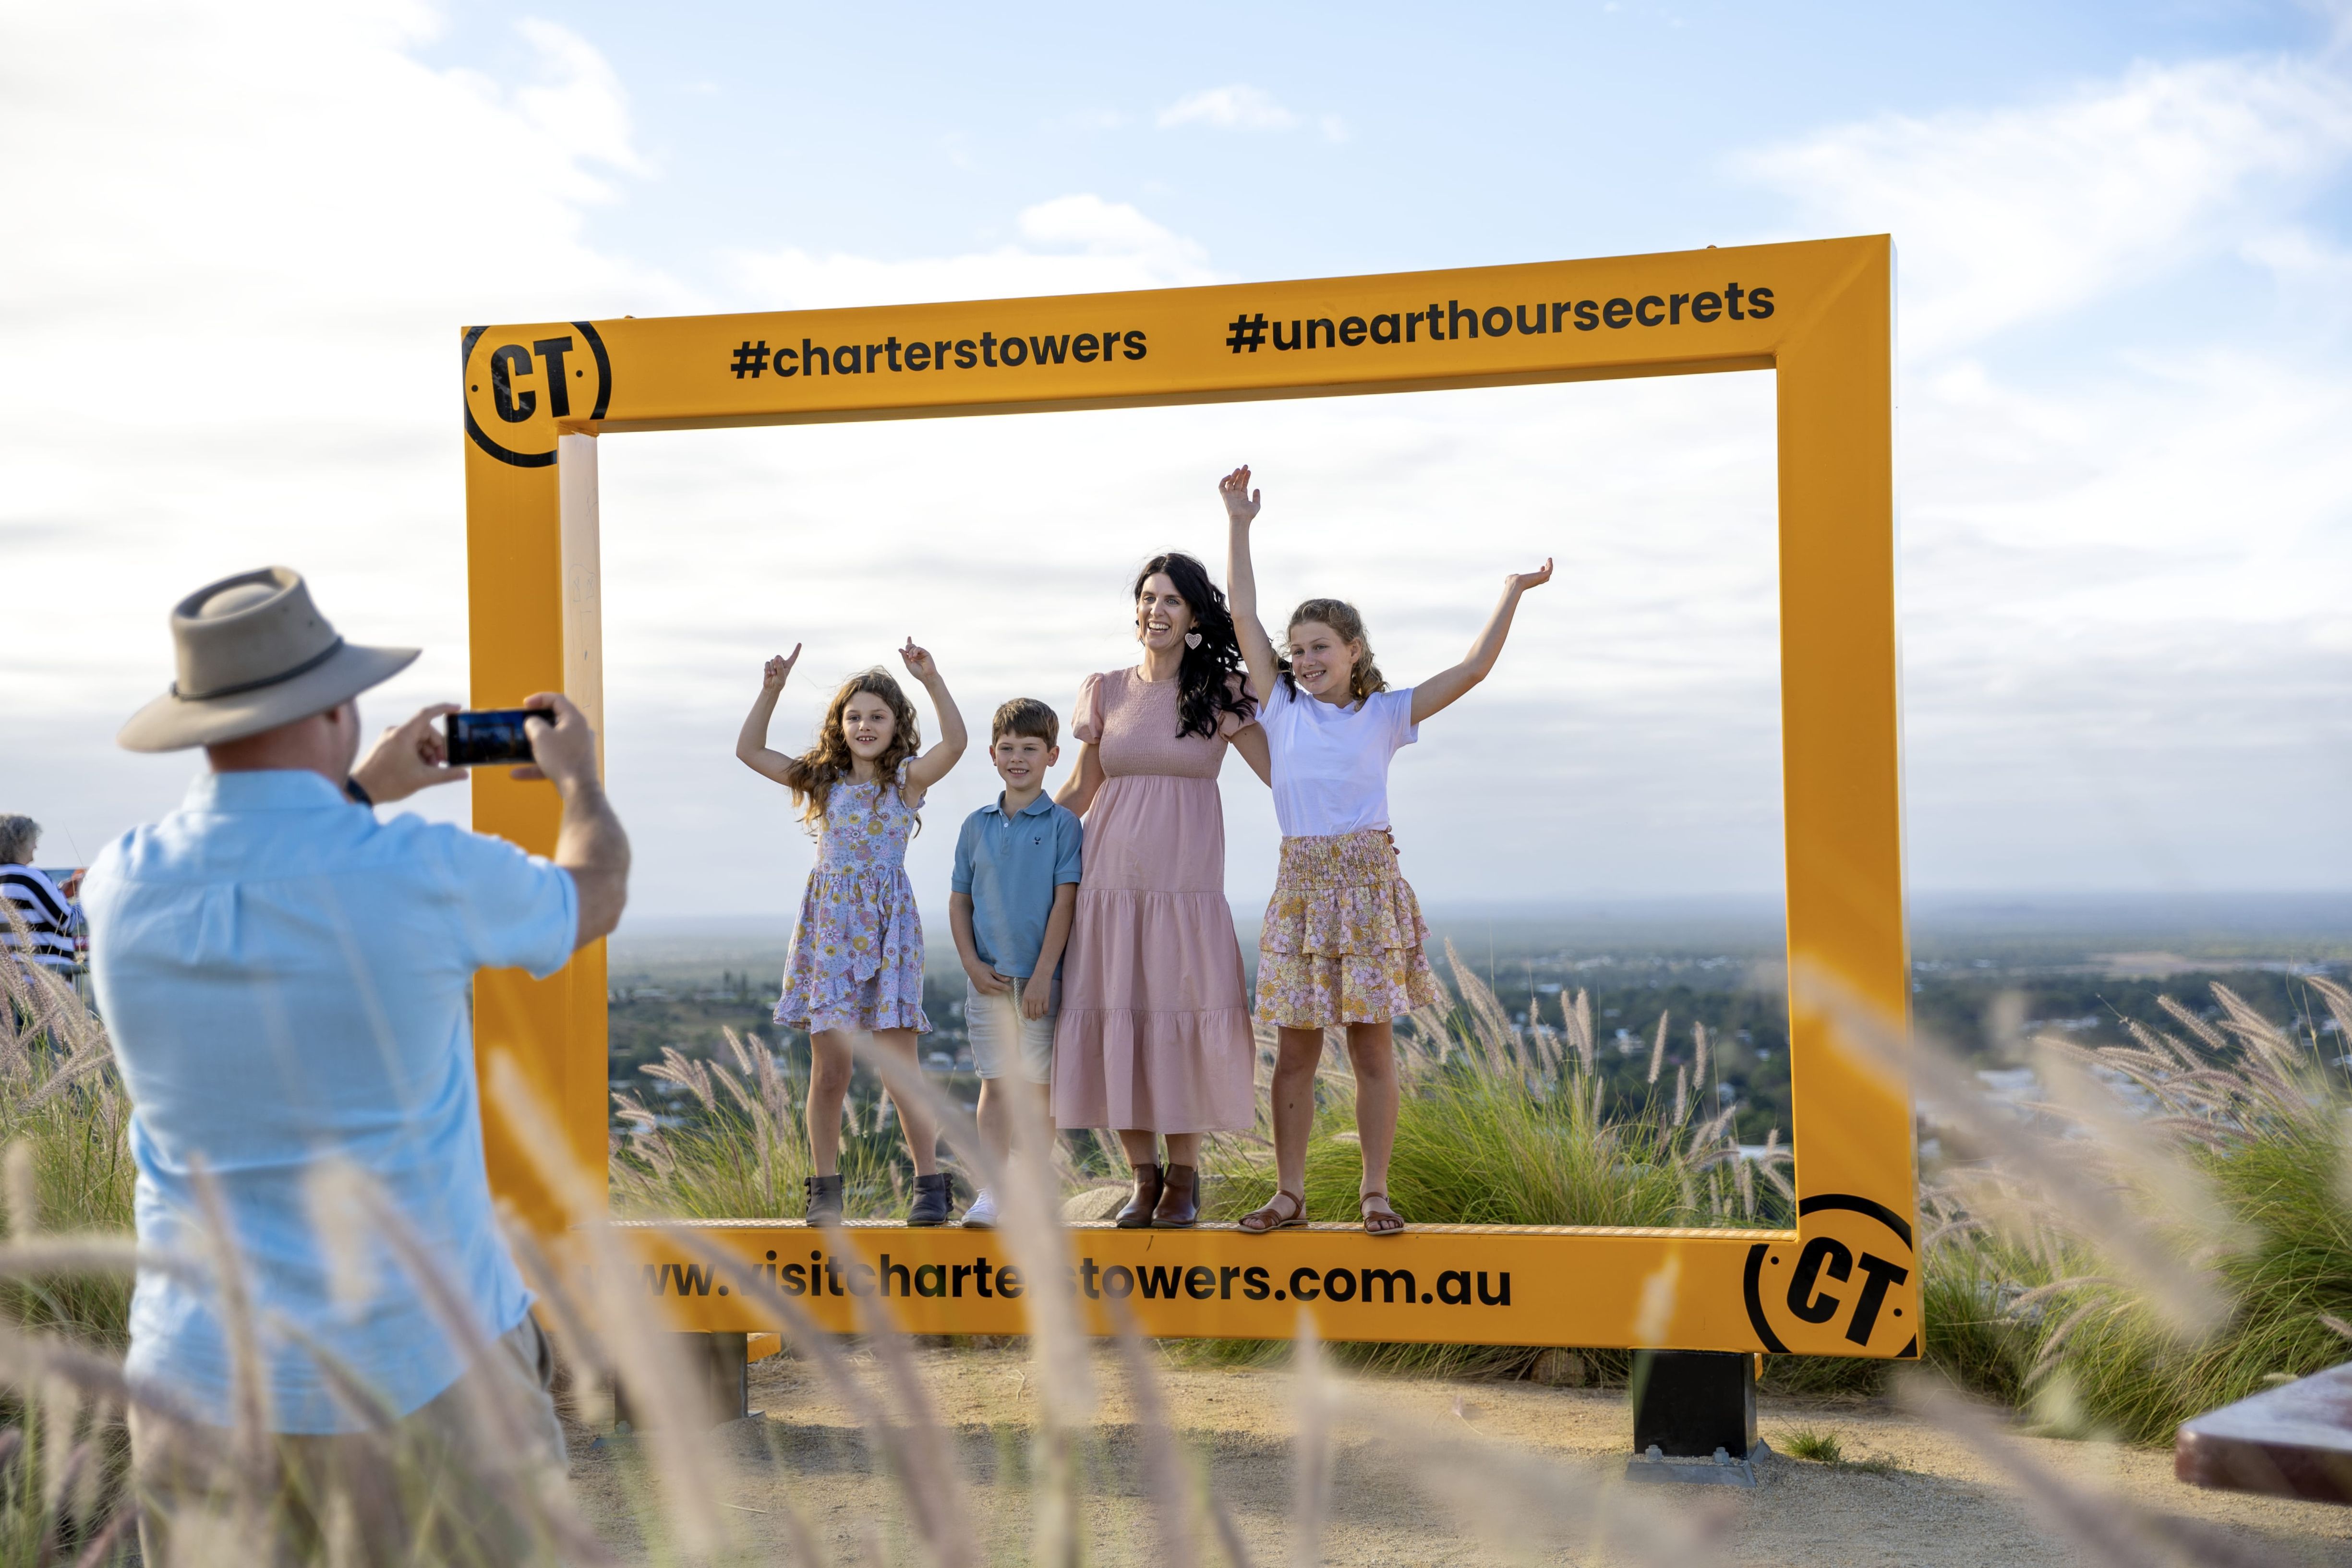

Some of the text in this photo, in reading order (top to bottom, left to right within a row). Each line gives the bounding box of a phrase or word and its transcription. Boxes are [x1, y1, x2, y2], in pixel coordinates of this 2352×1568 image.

[730, 330, 1147, 379] #charterstowers
[1226, 282, 1775, 354] #unearthoursecrets
[490, 336, 573, 423] CT
[1786, 1236, 1909, 1347] CT
